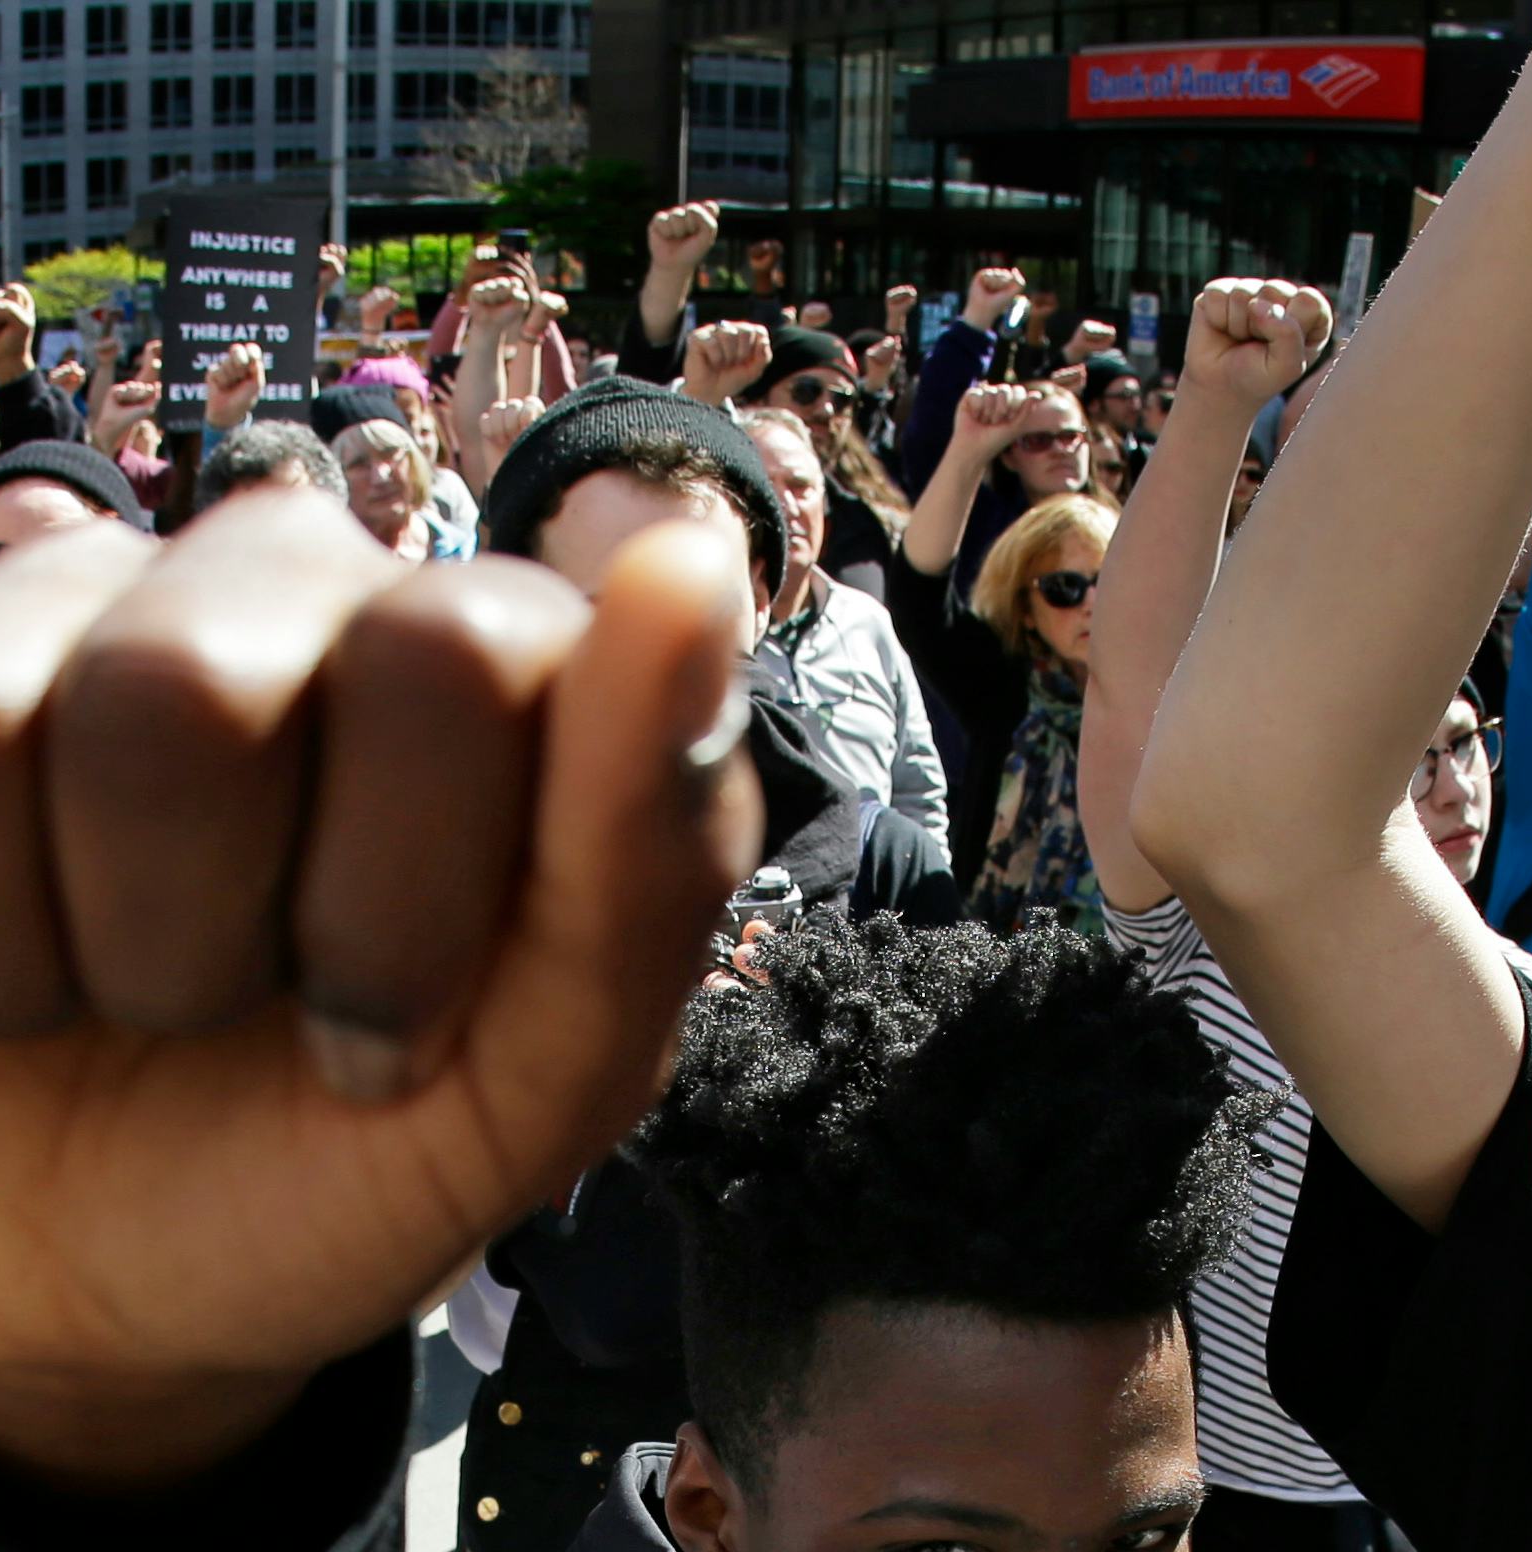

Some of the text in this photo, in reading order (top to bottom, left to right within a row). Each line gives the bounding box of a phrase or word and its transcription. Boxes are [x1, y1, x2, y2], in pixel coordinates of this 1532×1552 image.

[1087, 60, 1291, 103] Bank of America
[190, 231, 296, 255] INJUSTICE
[181, 265, 293, 289] ANYWHERE
[205, 292, 269, 312] IS A
[179, 323, 290, 342] THREAT TO
